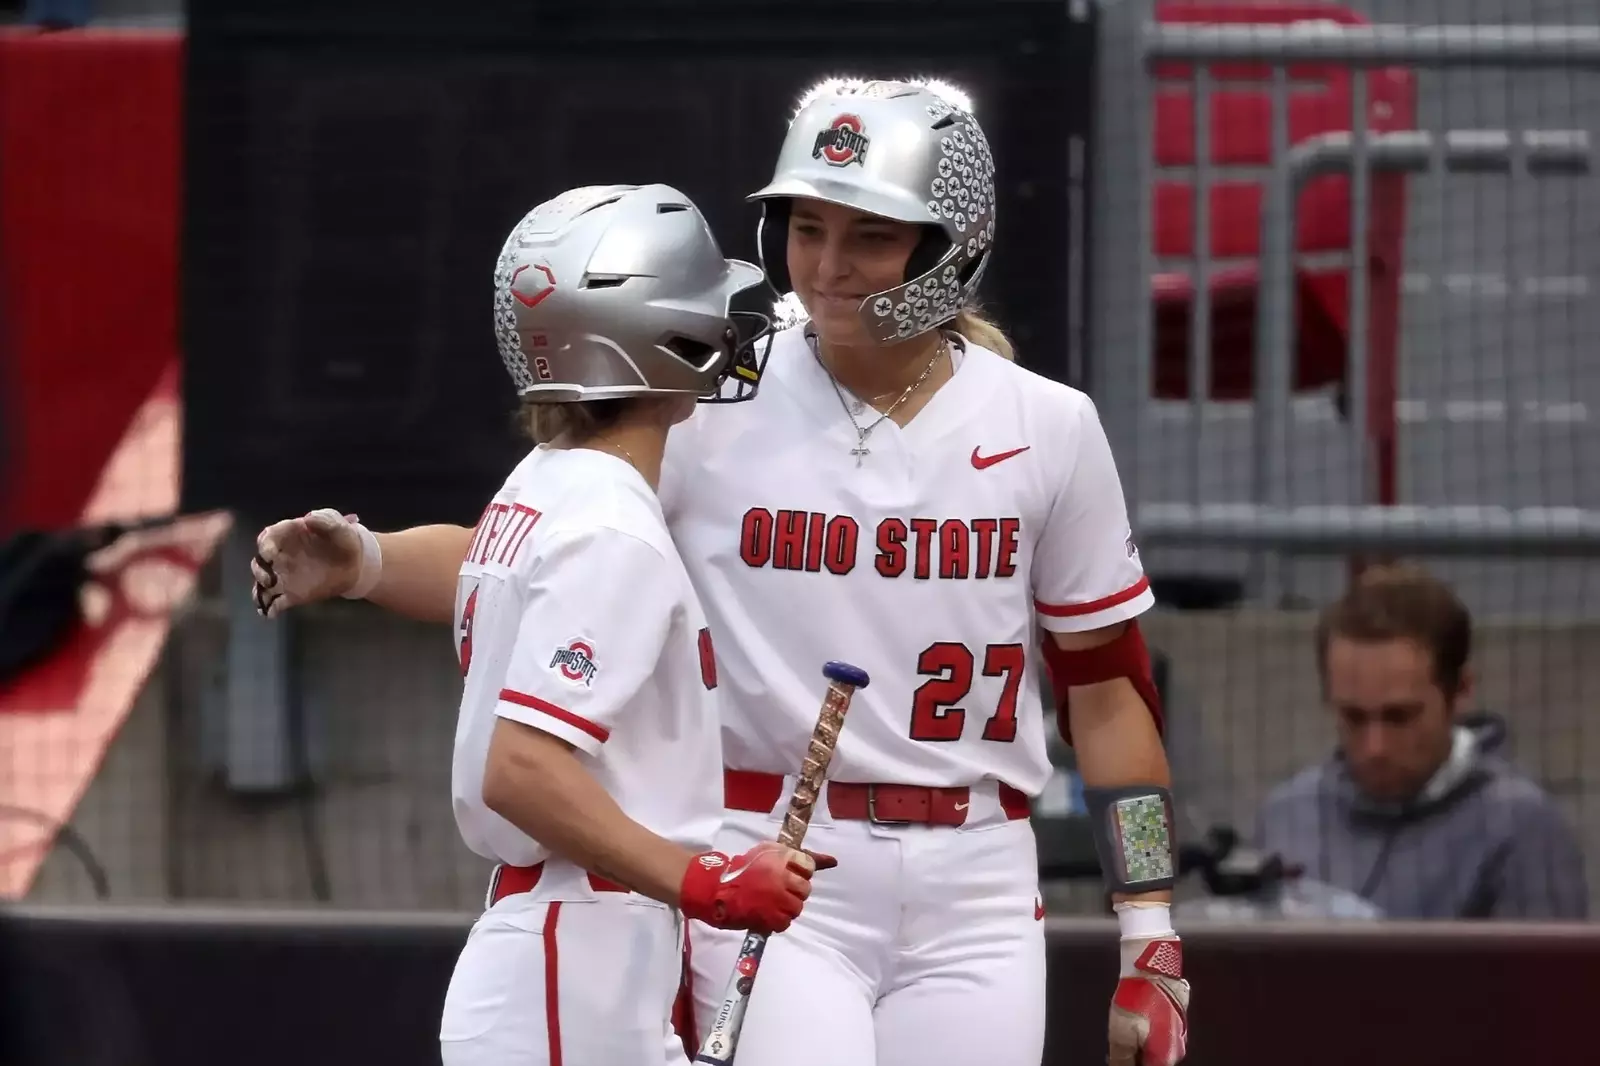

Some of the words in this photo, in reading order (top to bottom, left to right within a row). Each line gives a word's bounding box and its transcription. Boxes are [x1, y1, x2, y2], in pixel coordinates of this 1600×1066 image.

[836, 127, 868, 166] STATE
[535, 356, 552, 380] 2
[739, 507, 859, 576] OHIO
[874, 517, 1019, 579] STATE
[549, 649, 575, 668] OHIO
[570, 651, 597, 687] STATE
[909, 641, 1025, 742] 27
